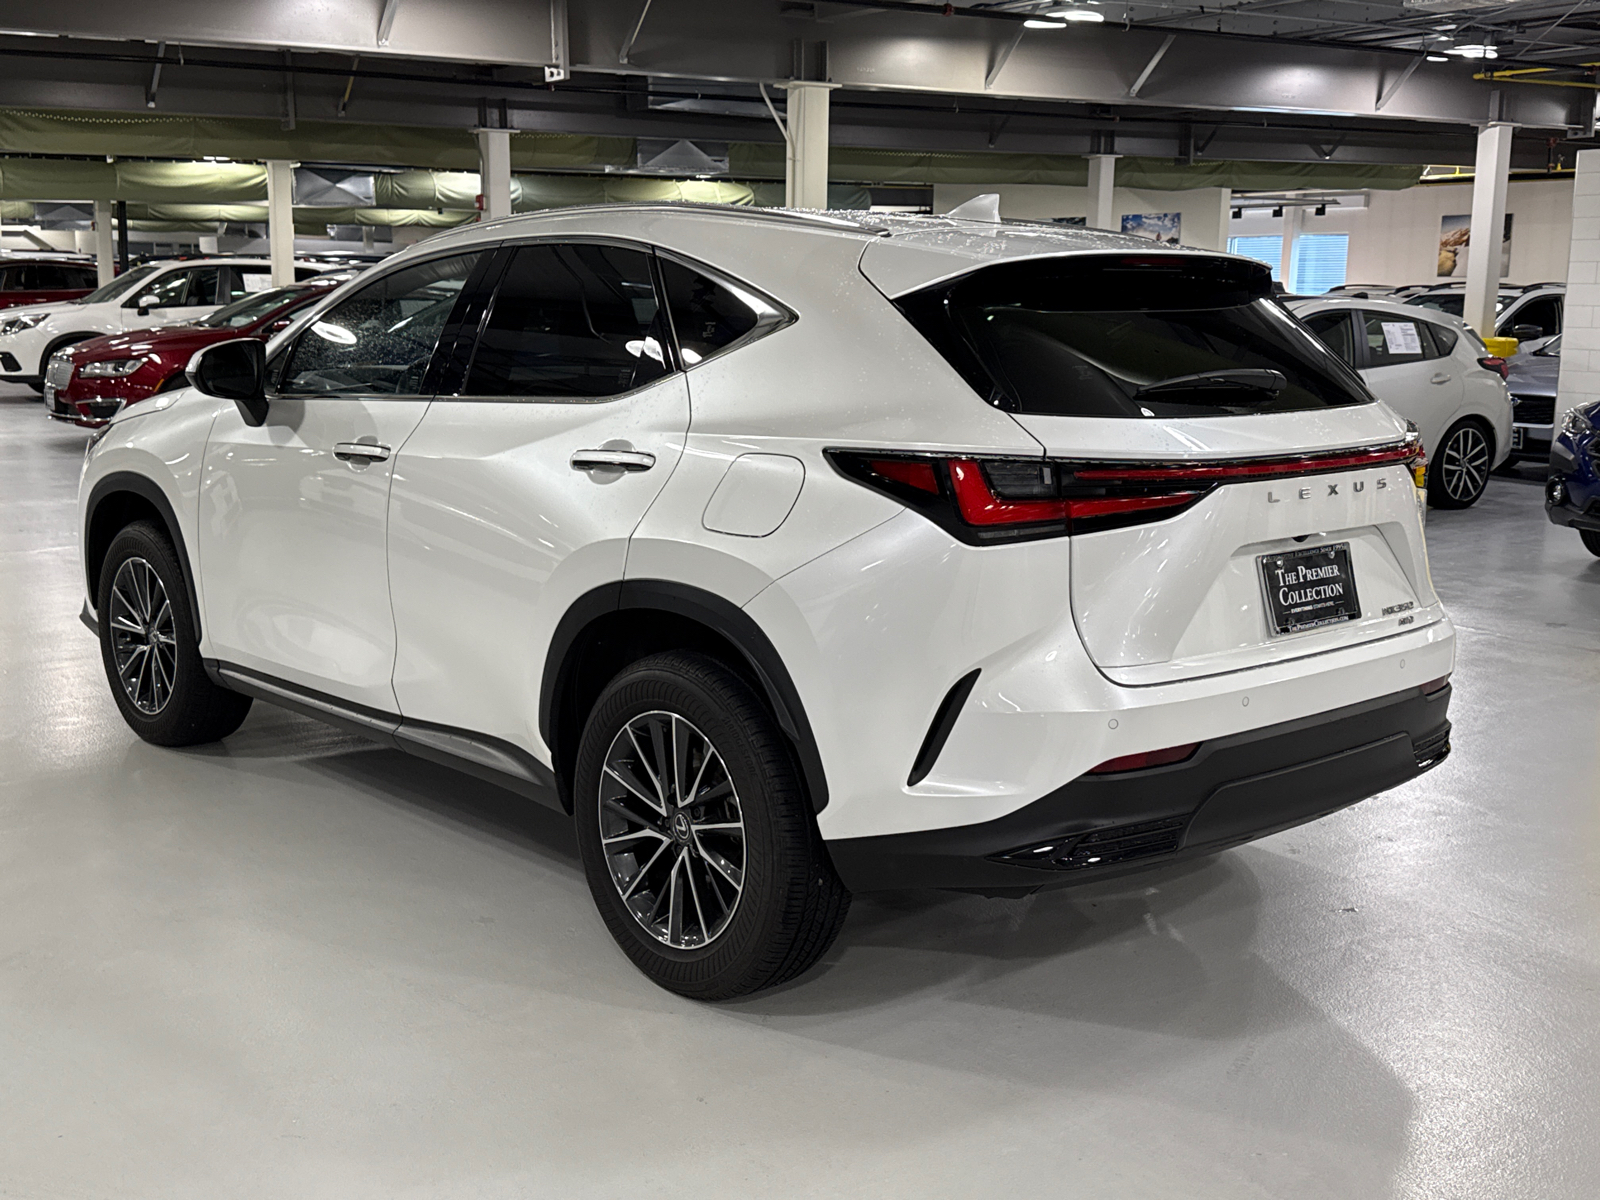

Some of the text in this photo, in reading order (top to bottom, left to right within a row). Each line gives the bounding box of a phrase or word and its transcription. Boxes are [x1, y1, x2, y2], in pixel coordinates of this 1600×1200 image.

[1267, 478, 1387, 504] LEXUS
[1274, 564, 1340, 587] THE PREMIER
[1279, 583, 1344, 606] COLLECTION
